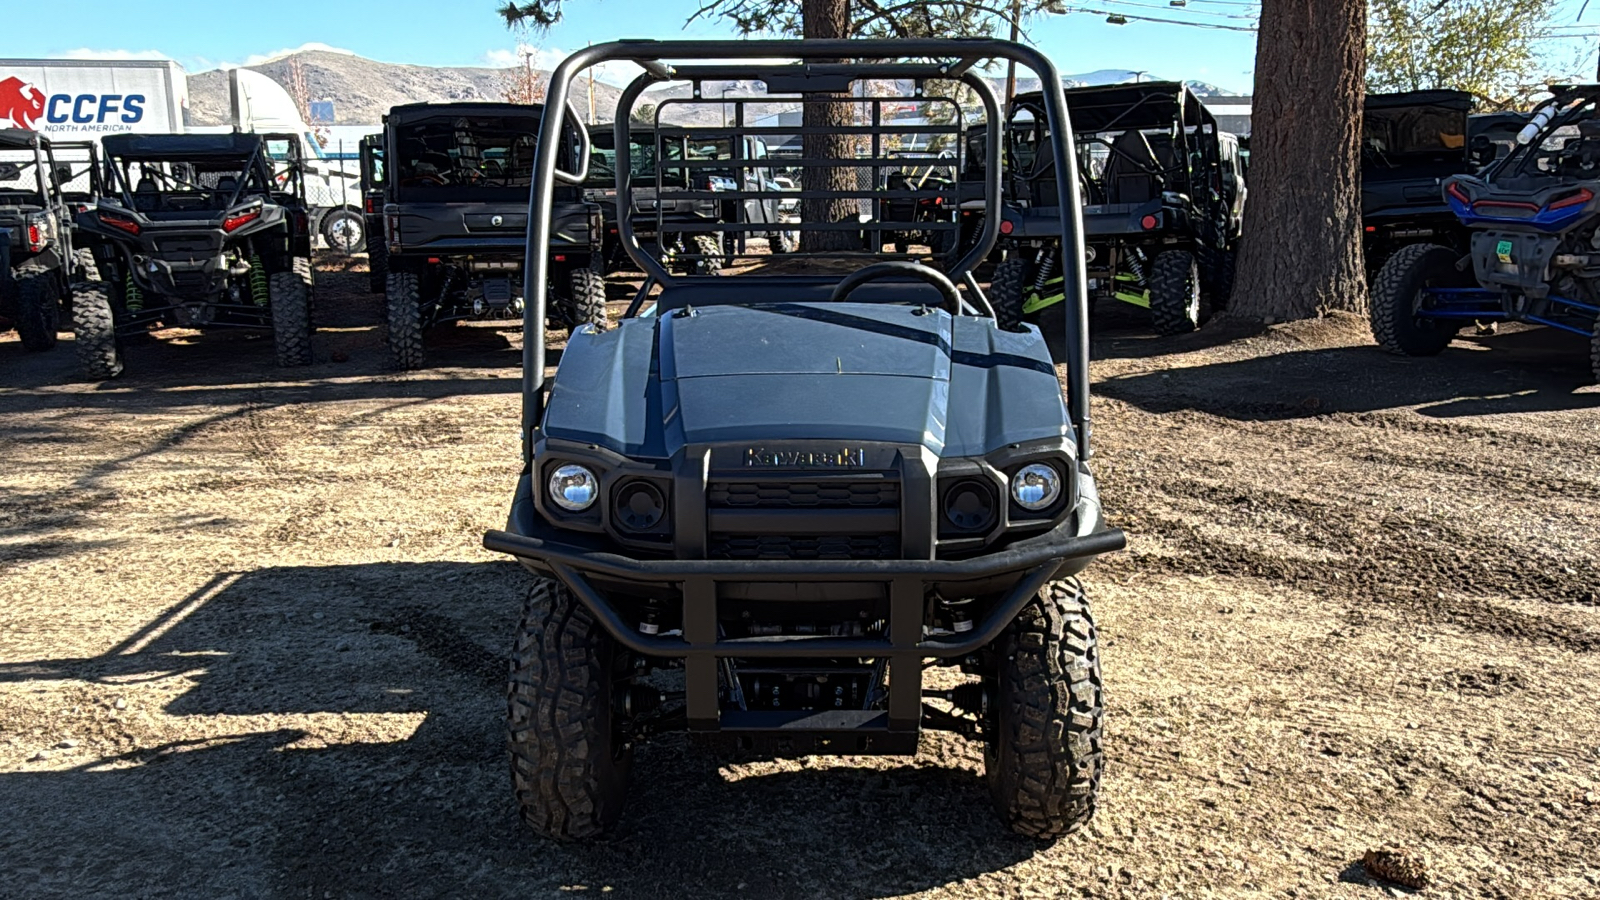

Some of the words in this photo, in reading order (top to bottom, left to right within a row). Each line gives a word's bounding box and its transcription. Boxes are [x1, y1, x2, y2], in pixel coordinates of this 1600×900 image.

[46, 93, 146, 124] CCFS
[44, 124, 78, 132] NORTH
[80, 124, 132, 132] AMERICAN
[744, 447, 864, 467] Kawasaki
